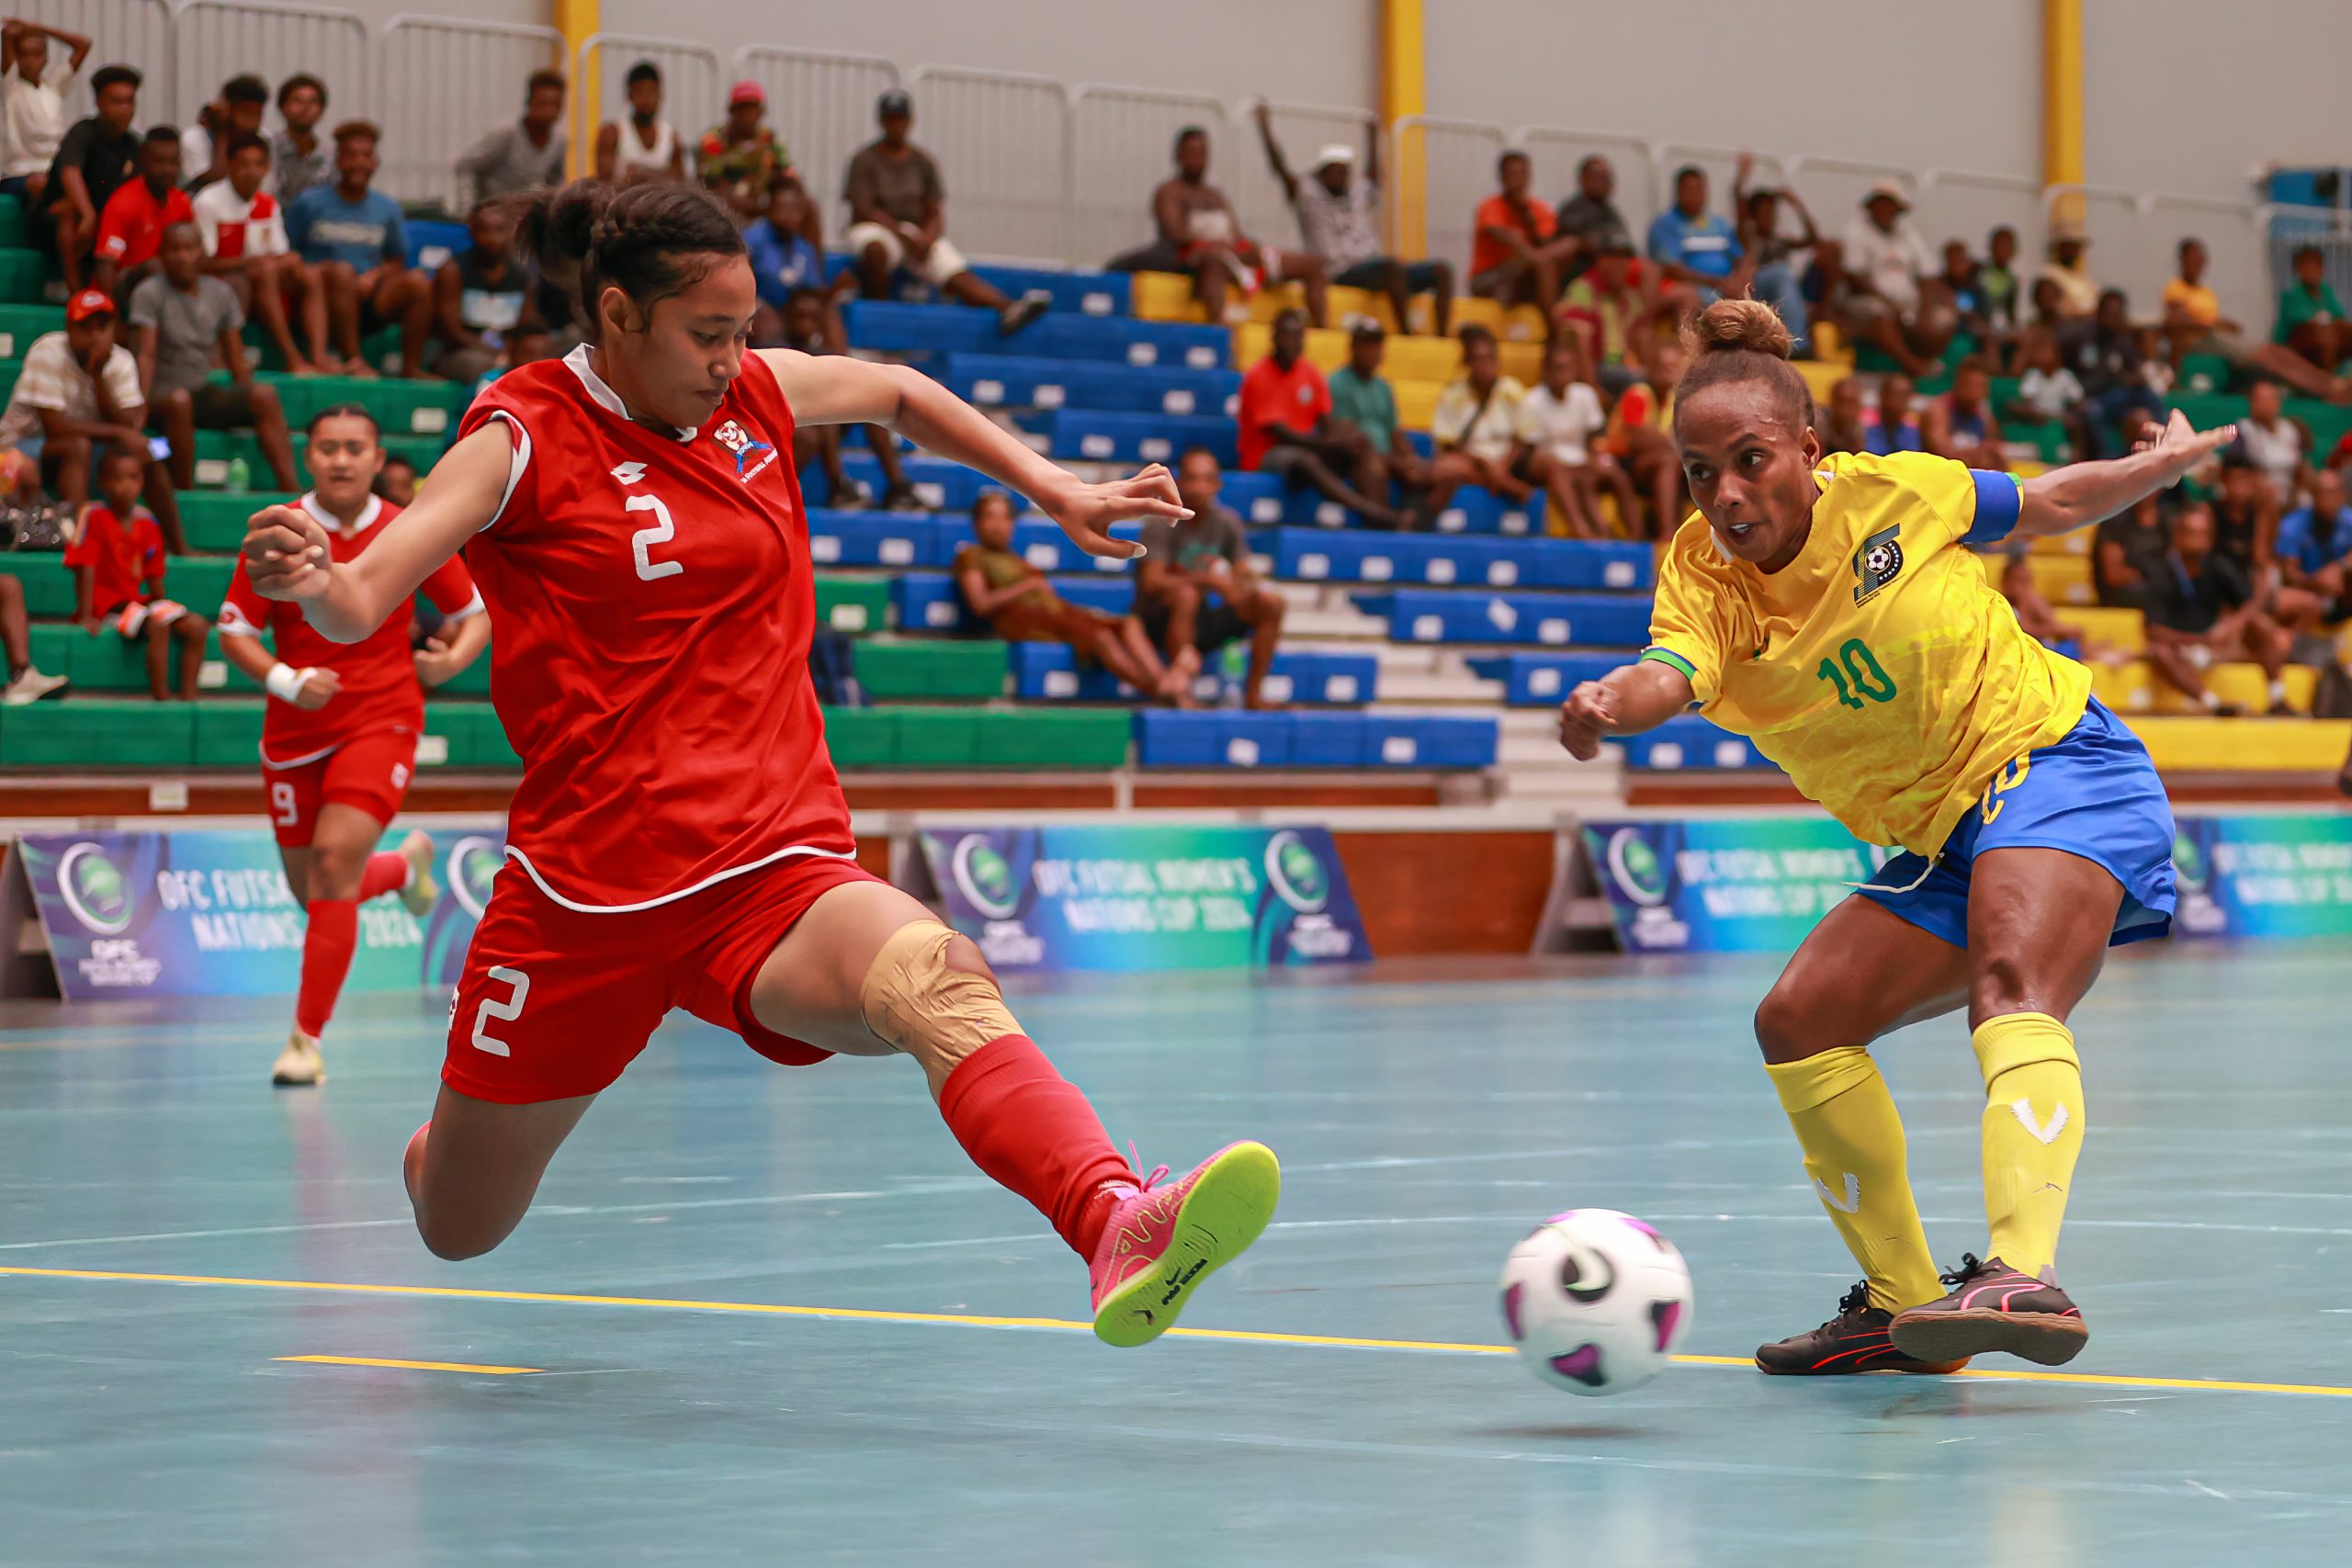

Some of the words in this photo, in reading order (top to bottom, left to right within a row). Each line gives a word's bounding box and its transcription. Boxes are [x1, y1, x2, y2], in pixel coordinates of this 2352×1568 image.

[625, 494, 684, 581] 2
[1816, 637, 1897, 709] 10
[271, 782, 299, 826] 9
[156, 869, 211, 911] OFC
[210, 868, 301, 909] FUTSA
[191, 911, 305, 952] NATIONS
[471, 964, 530, 1057] 2
